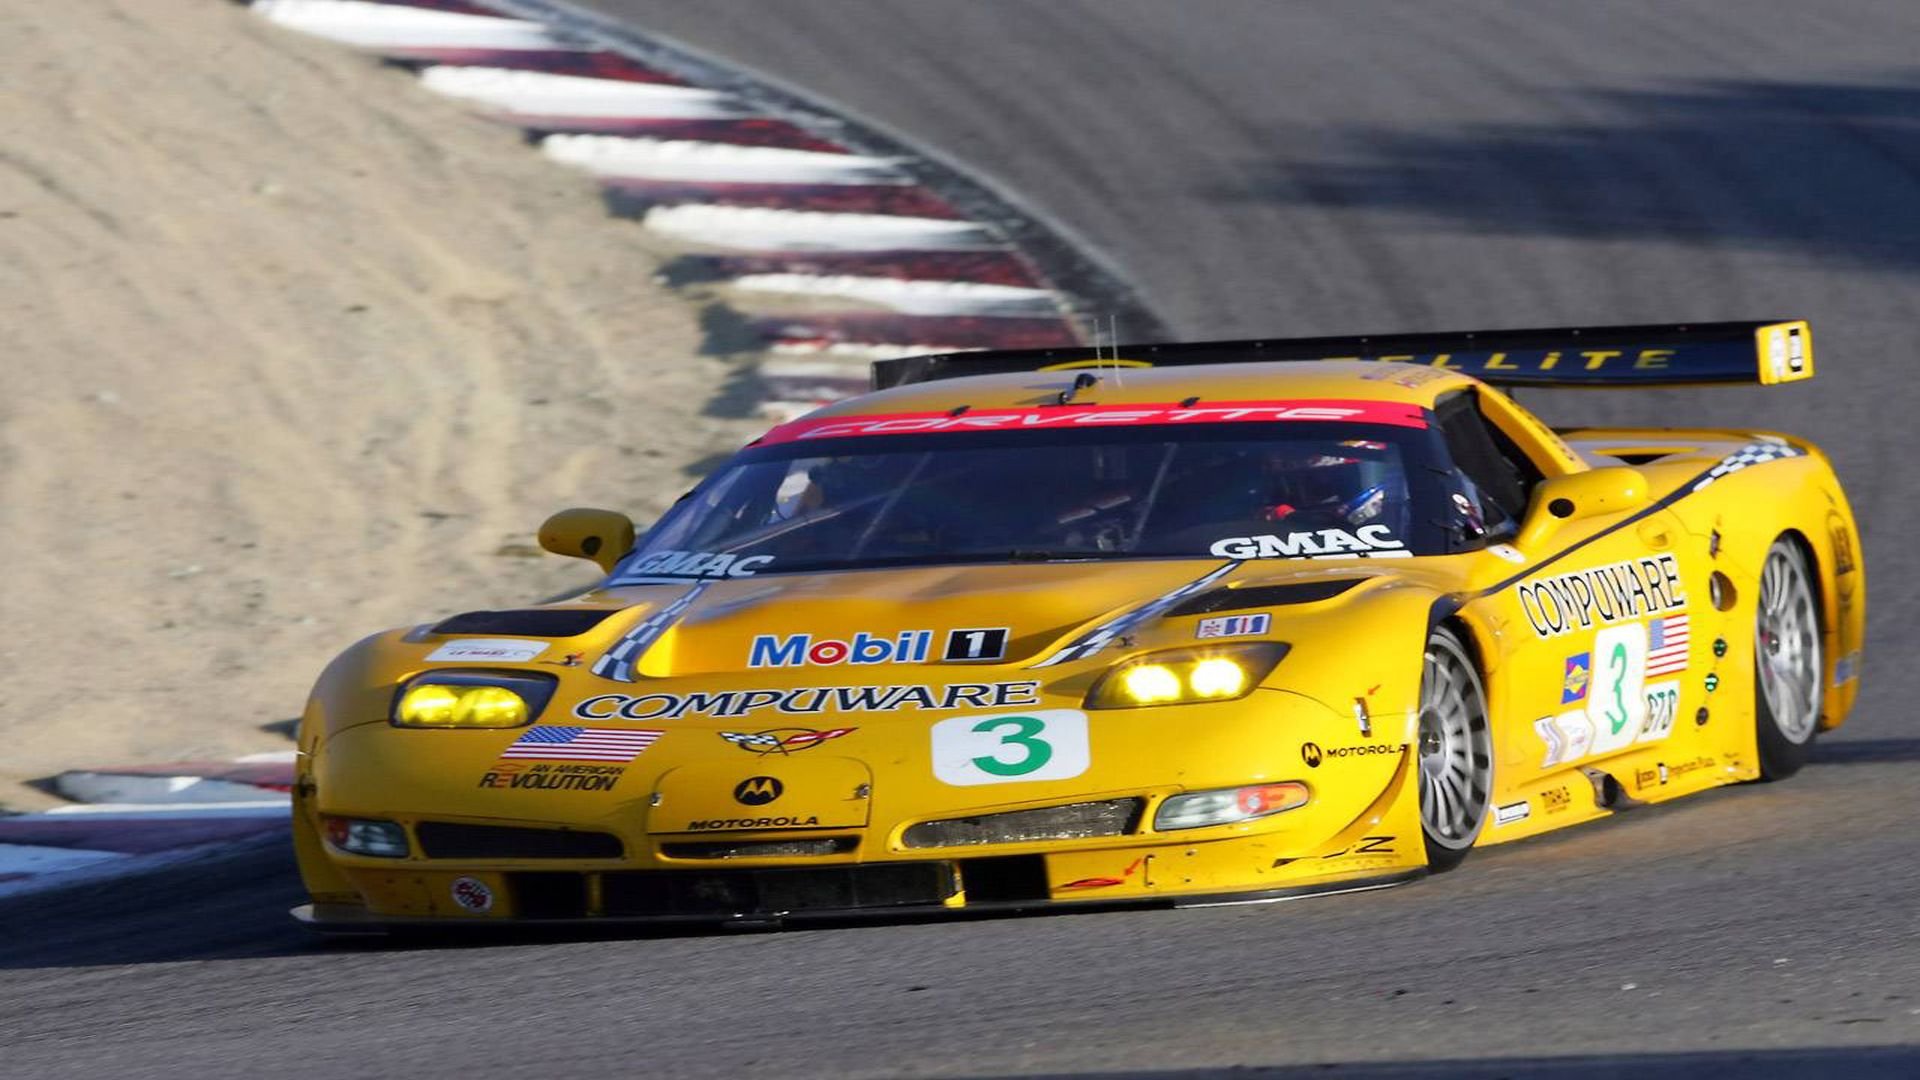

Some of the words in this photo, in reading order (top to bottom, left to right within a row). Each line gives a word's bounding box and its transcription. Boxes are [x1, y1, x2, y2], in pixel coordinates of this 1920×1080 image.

[798, 407, 1364, 439] CORVETTE
[1210, 524, 1404, 559] GMAC
[626, 551, 775, 577] GMAC
[1519, 555, 1685, 636] COMPUWARE
[748, 631, 932, 667] Mobil
[574, 680, 1041, 720] COMPUWARE
[1604, 642, 1628, 735] 3
[970, 716, 1053, 777] 3
[1326, 744, 1408, 758] MOTOROLA
[479, 772, 619, 791] REVOLUTION
[530, 764, 551, 773] AN
[554, 765, 625, 775] AMERICAN
[688, 816, 819, 831] MOTOROLA
